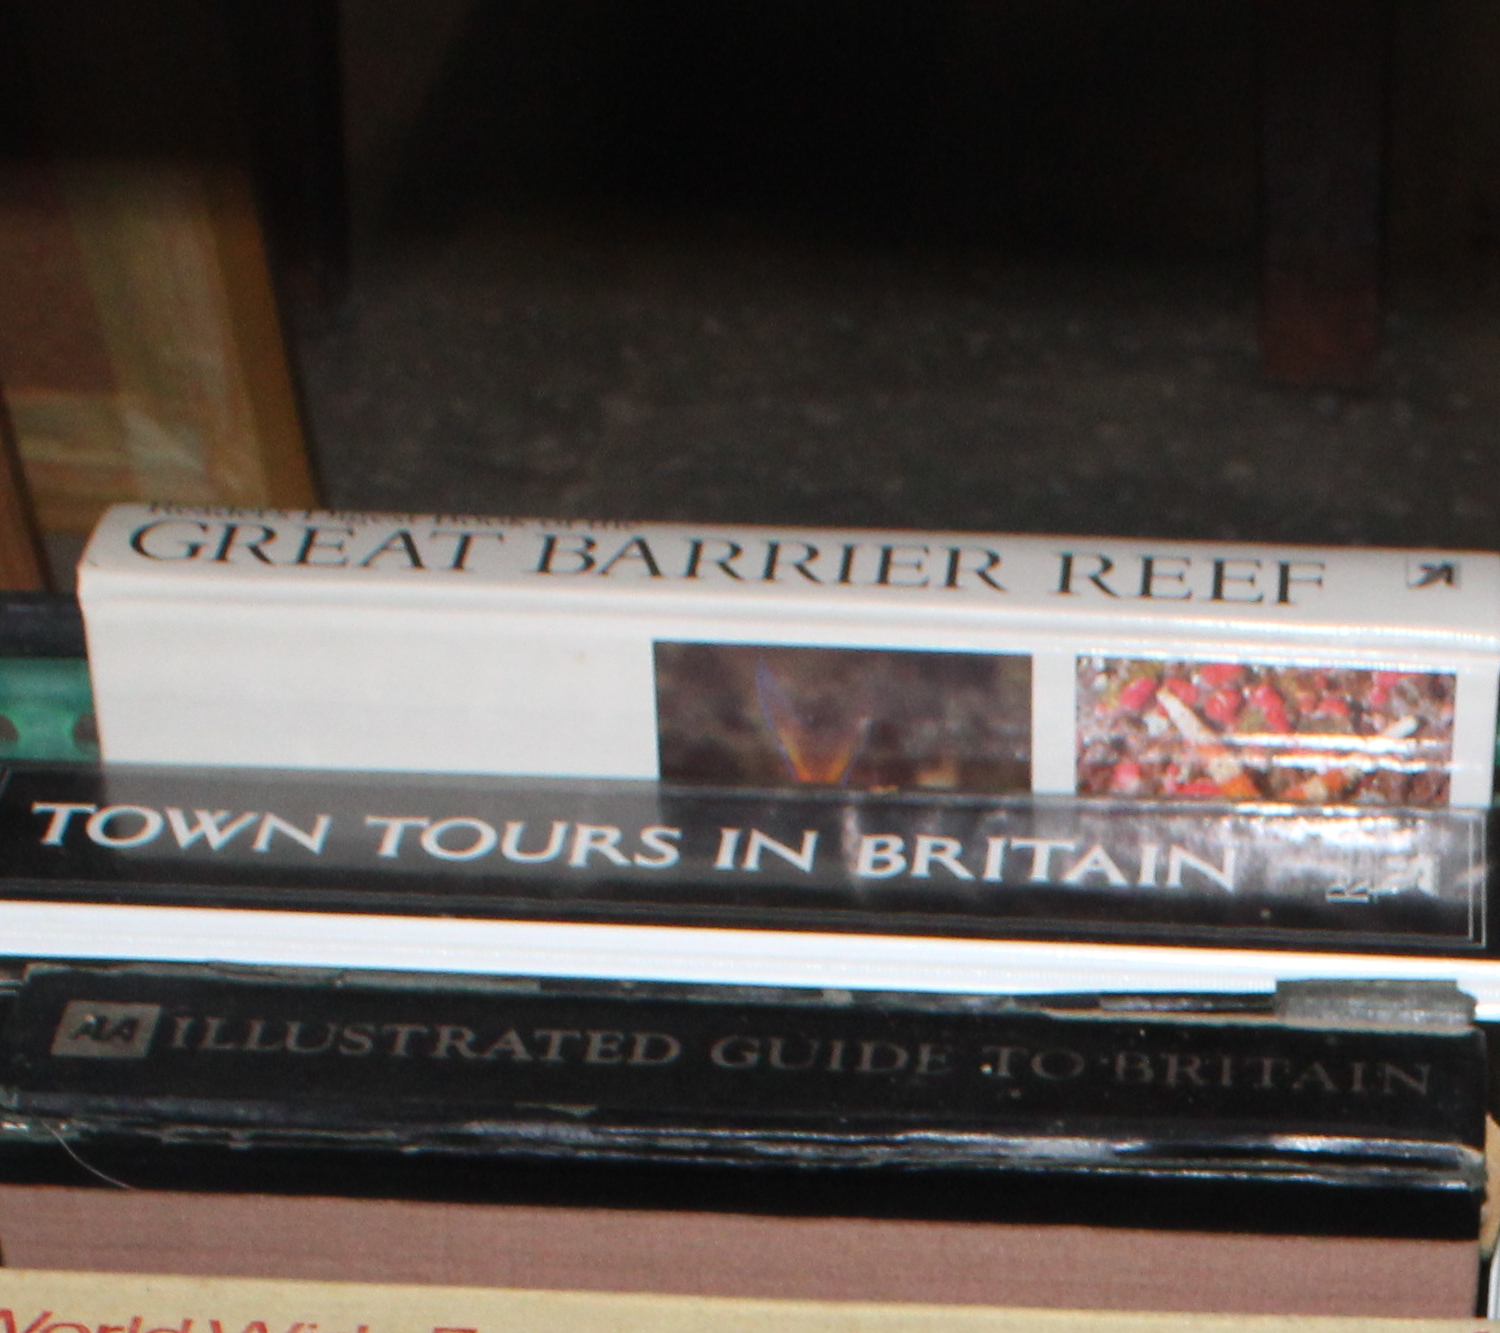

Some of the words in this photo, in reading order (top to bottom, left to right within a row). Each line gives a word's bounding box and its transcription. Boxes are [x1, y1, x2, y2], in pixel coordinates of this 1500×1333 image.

[128, 518, 505, 572] GREAT
[529, 532, 1010, 593] BARRIER
[1054, 551, 1327, 606] REEF
[30, 801, 334, 856] TOWN
[363, 814, 683, 870] TOURS
[713, 826, 820, 874] IN
[854, 832, 1239, 892] BRITAIN
[67, 1014, 141, 1046] AA
[167, 1014, 683, 1069] ILLUSTRATED
[709, 1034, 956, 1078] GUIDE
[979, 1043, 1087, 1083] TO
[1113, 1051, 1435, 1098] BRITAIN
